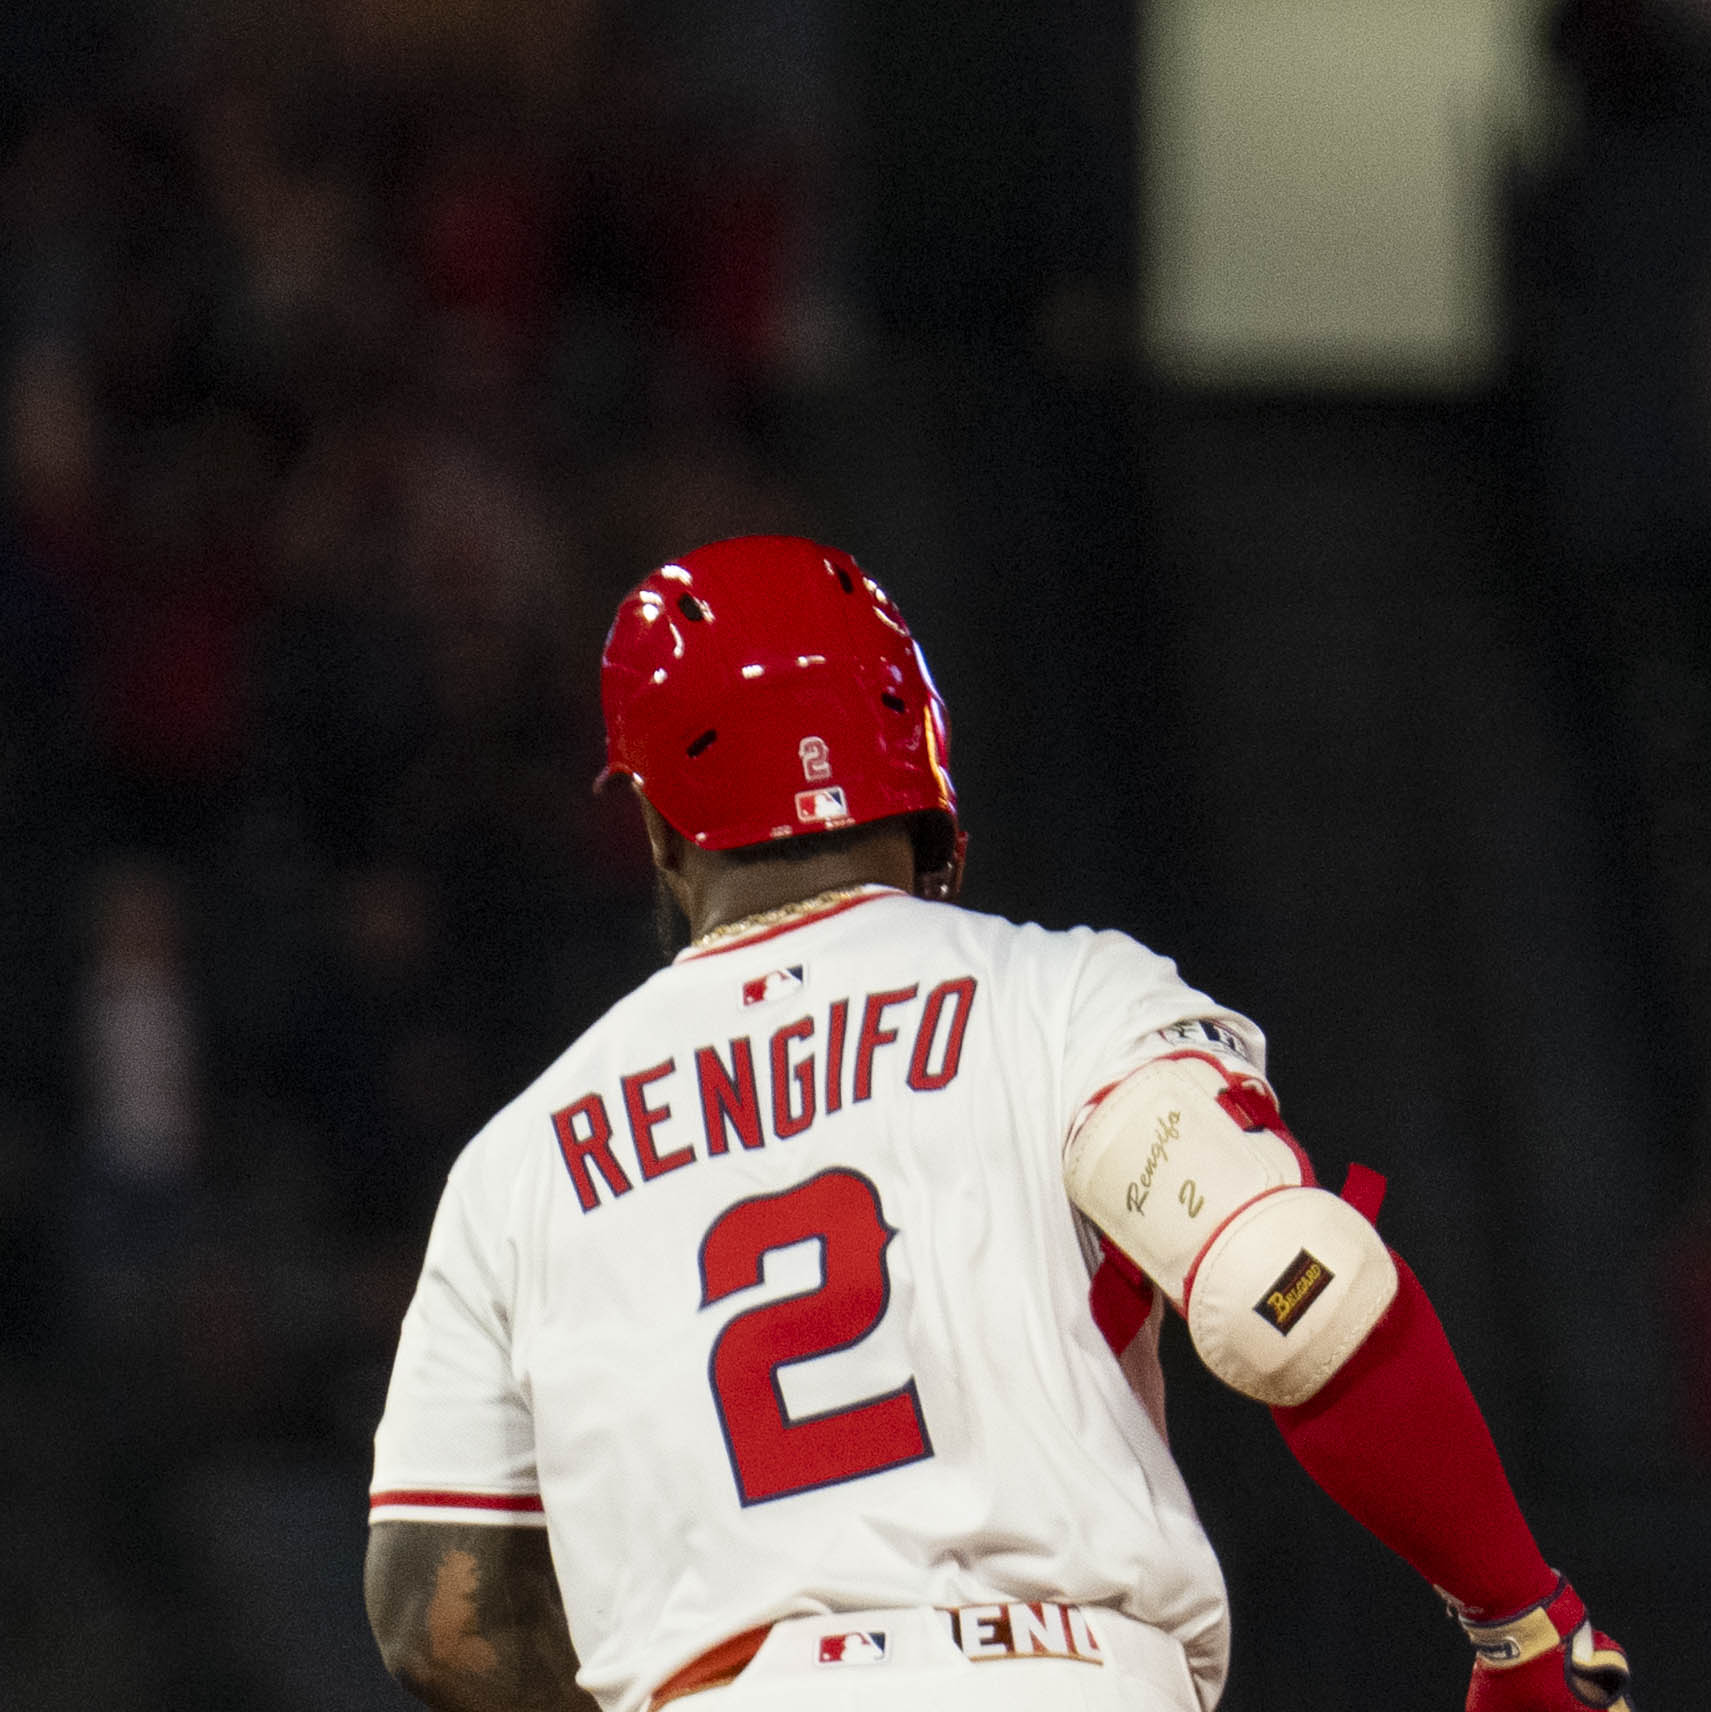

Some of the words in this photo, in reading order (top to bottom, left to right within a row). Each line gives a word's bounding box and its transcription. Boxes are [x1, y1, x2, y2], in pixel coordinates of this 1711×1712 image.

[798, 735, 832, 782] 2
[549, 974, 978, 1215] RENGIFO
[1179, 1179, 1205, 1218] 2
[696, 1166, 934, 1508] 2
